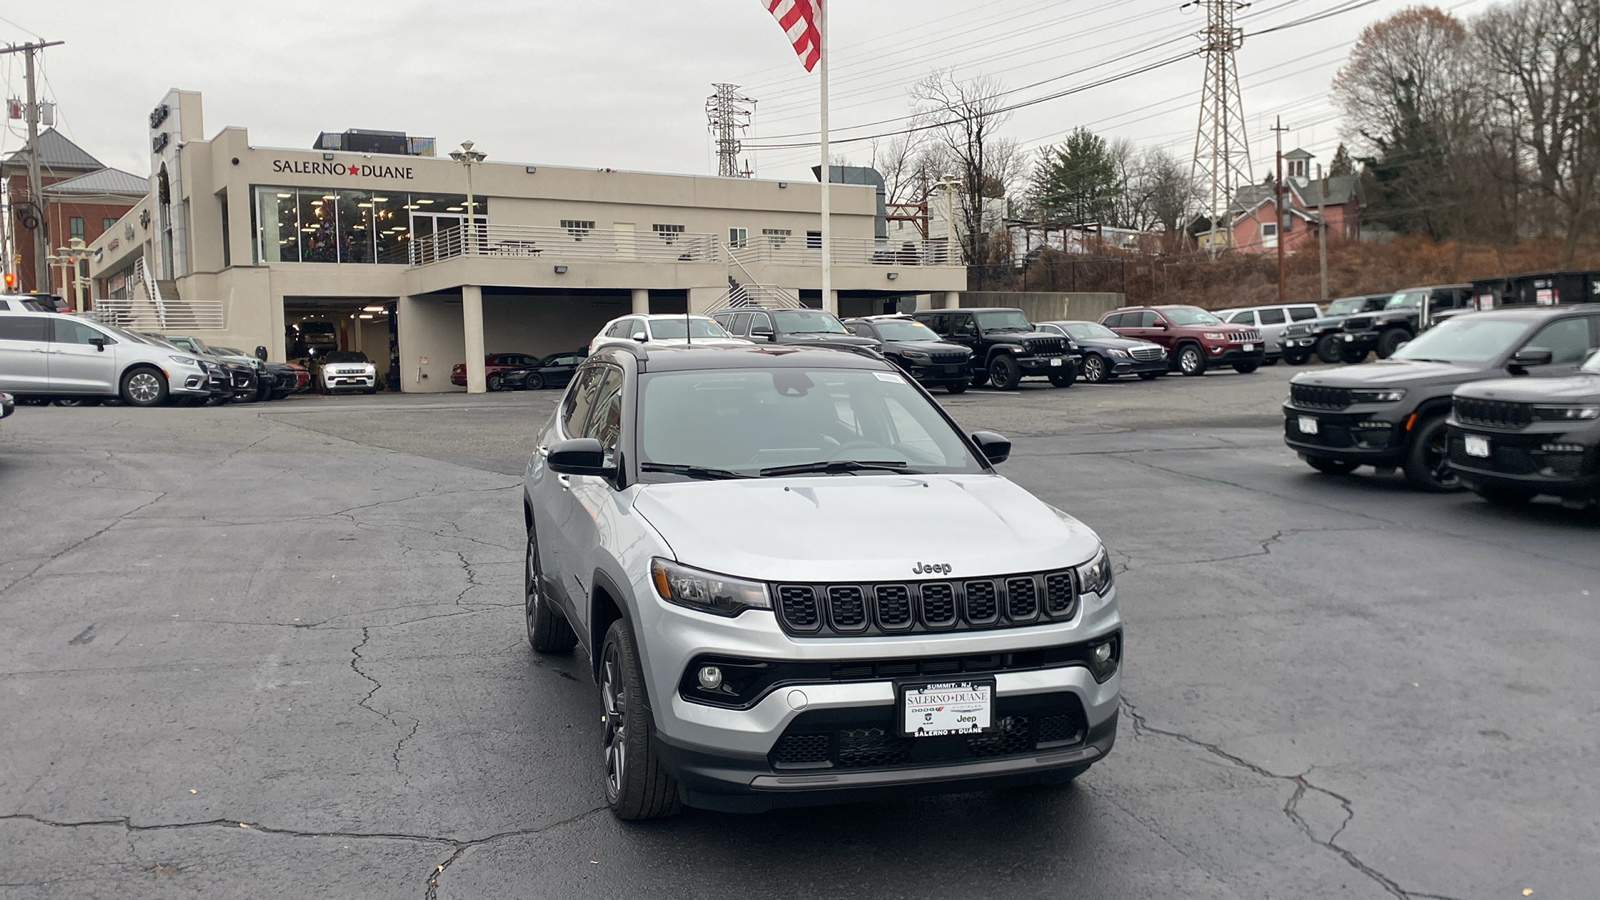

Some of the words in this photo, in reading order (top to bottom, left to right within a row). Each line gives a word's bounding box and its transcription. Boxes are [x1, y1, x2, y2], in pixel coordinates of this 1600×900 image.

[272, 159, 346, 176] SALERNO
[361, 165, 414, 180] DUANE
[912, 561, 952, 575] Jeep
[907, 694, 950, 705] SALERNO
[955, 692, 988, 702] DUANE
[957, 715, 977, 723] Jeep
[914, 729, 948, 738] SALERNO
[958, 727, 983, 735] DUANE
